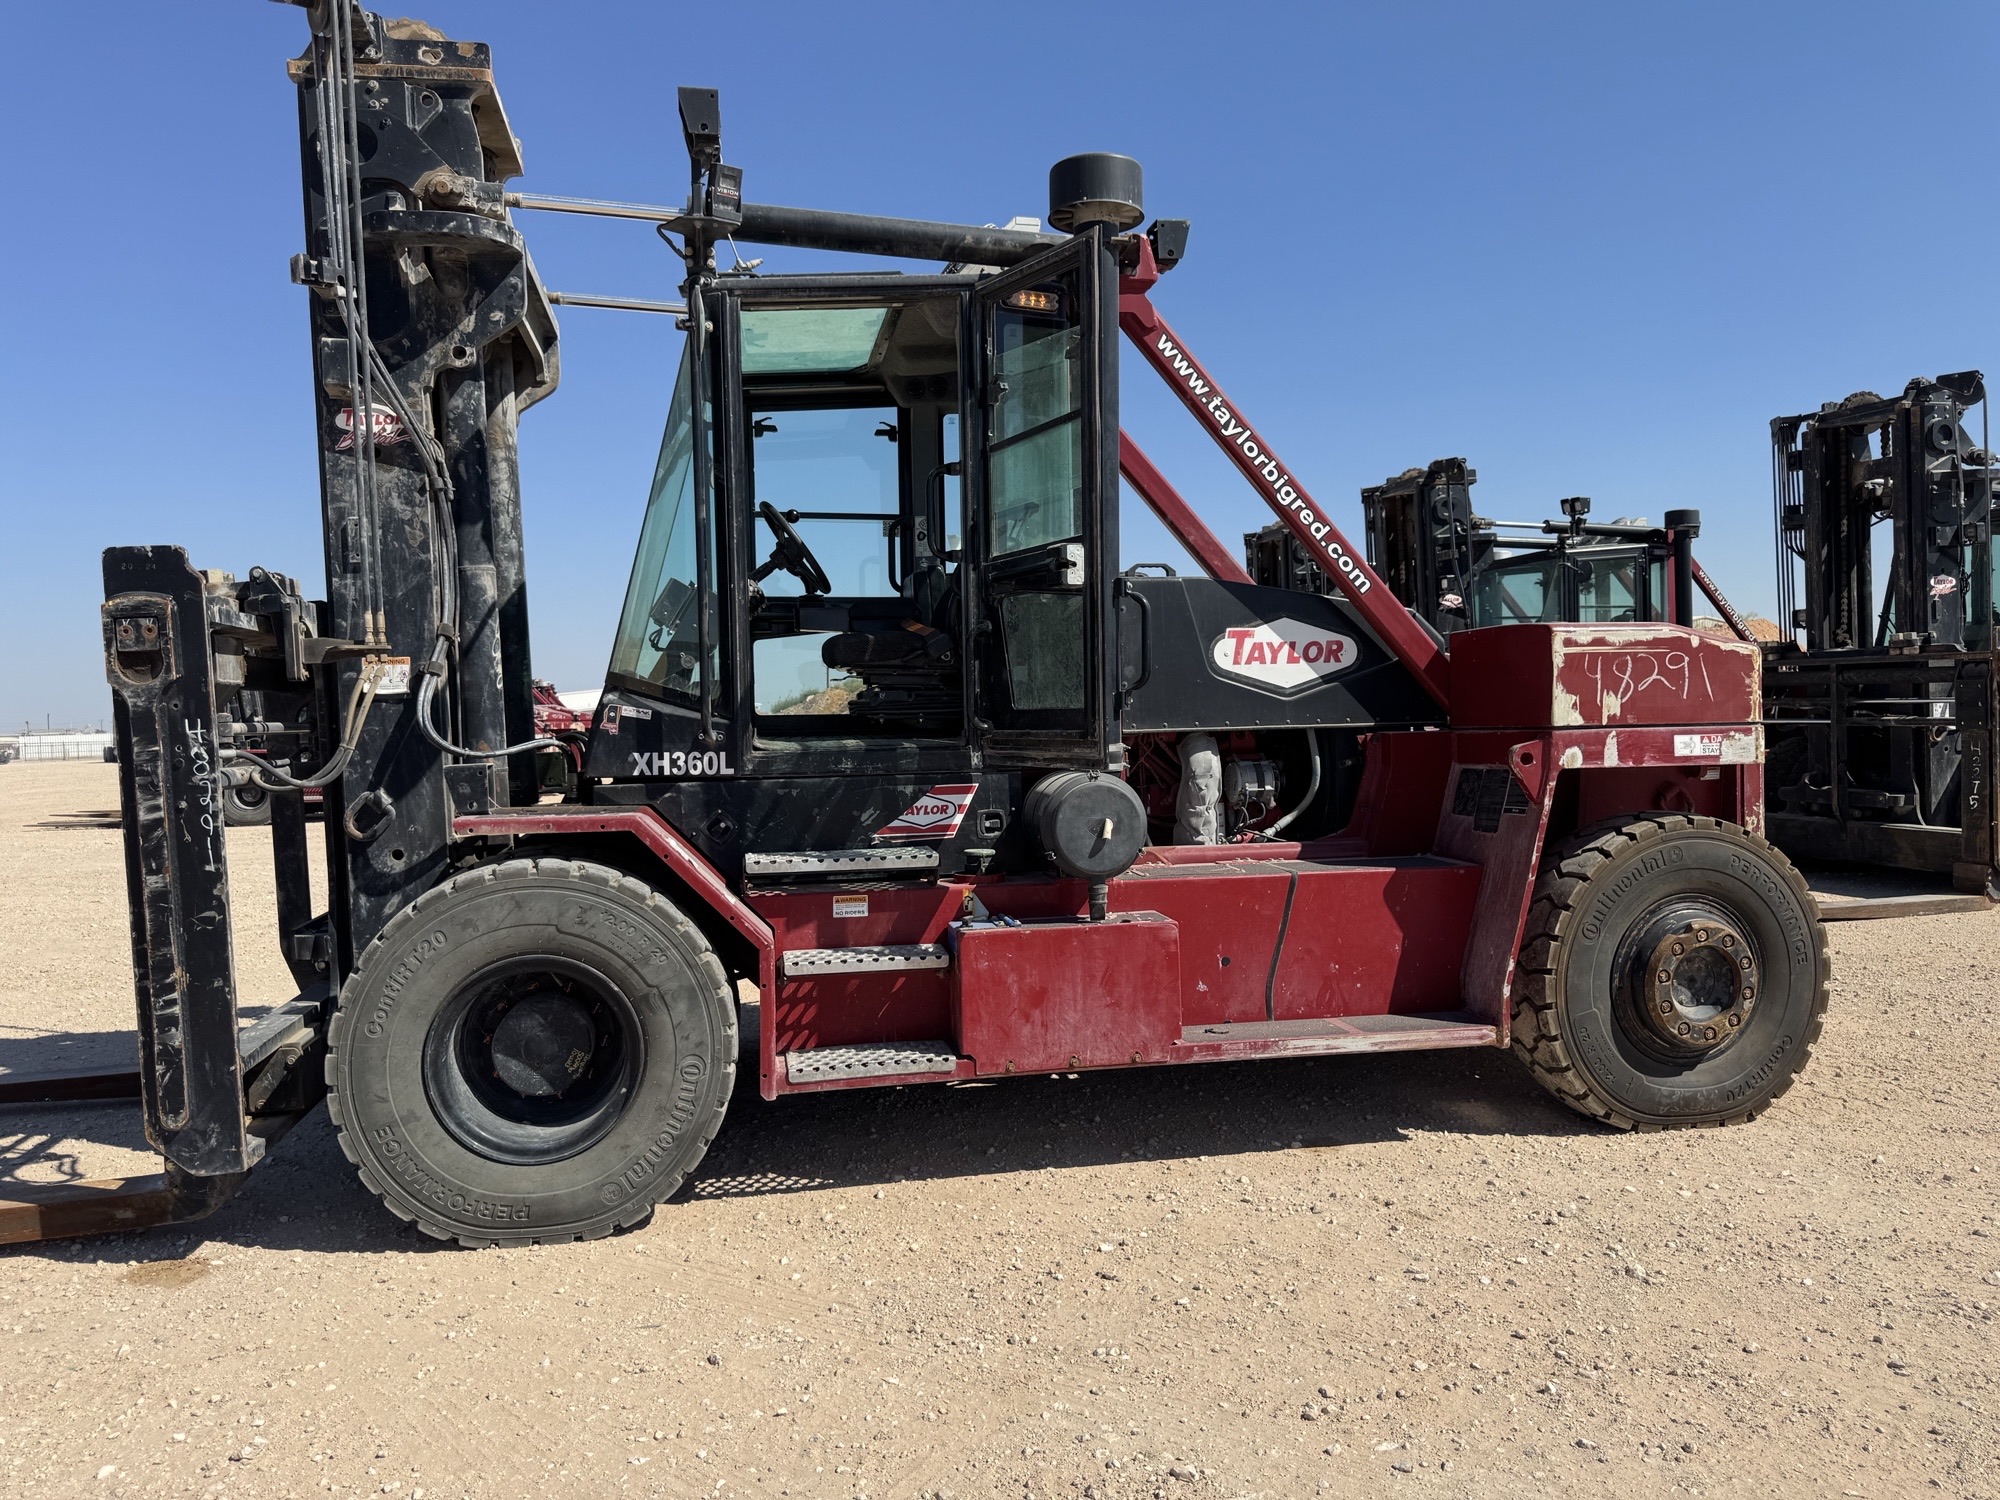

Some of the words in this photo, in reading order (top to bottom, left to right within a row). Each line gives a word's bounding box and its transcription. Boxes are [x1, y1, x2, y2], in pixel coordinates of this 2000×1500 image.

[717, 187, 739, 196] VISION
[341, 409, 406, 427] TALOR
[1156, 333, 1372, 595] www.taylorbigred.com
[1227, 629, 1344, 666] TAYLOR
[1698, 569, 1758, 645] www.taylorbigred.
[1584, 651, 1715, 707] 48291
[184, 718, 216, 873] 48291
[632, 751, 735, 776] XH360L
[905, 804, 949, 816] AYLOR
[1581, 850, 1667, 944] Continental
[1730, 853, 1808, 965] PERFORMANCE
[364, 930, 448, 1039] ContiRT20
[618, 1053, 708, 1194] Continental
[373, 1124, 532, 1222] PERFORMANCE
